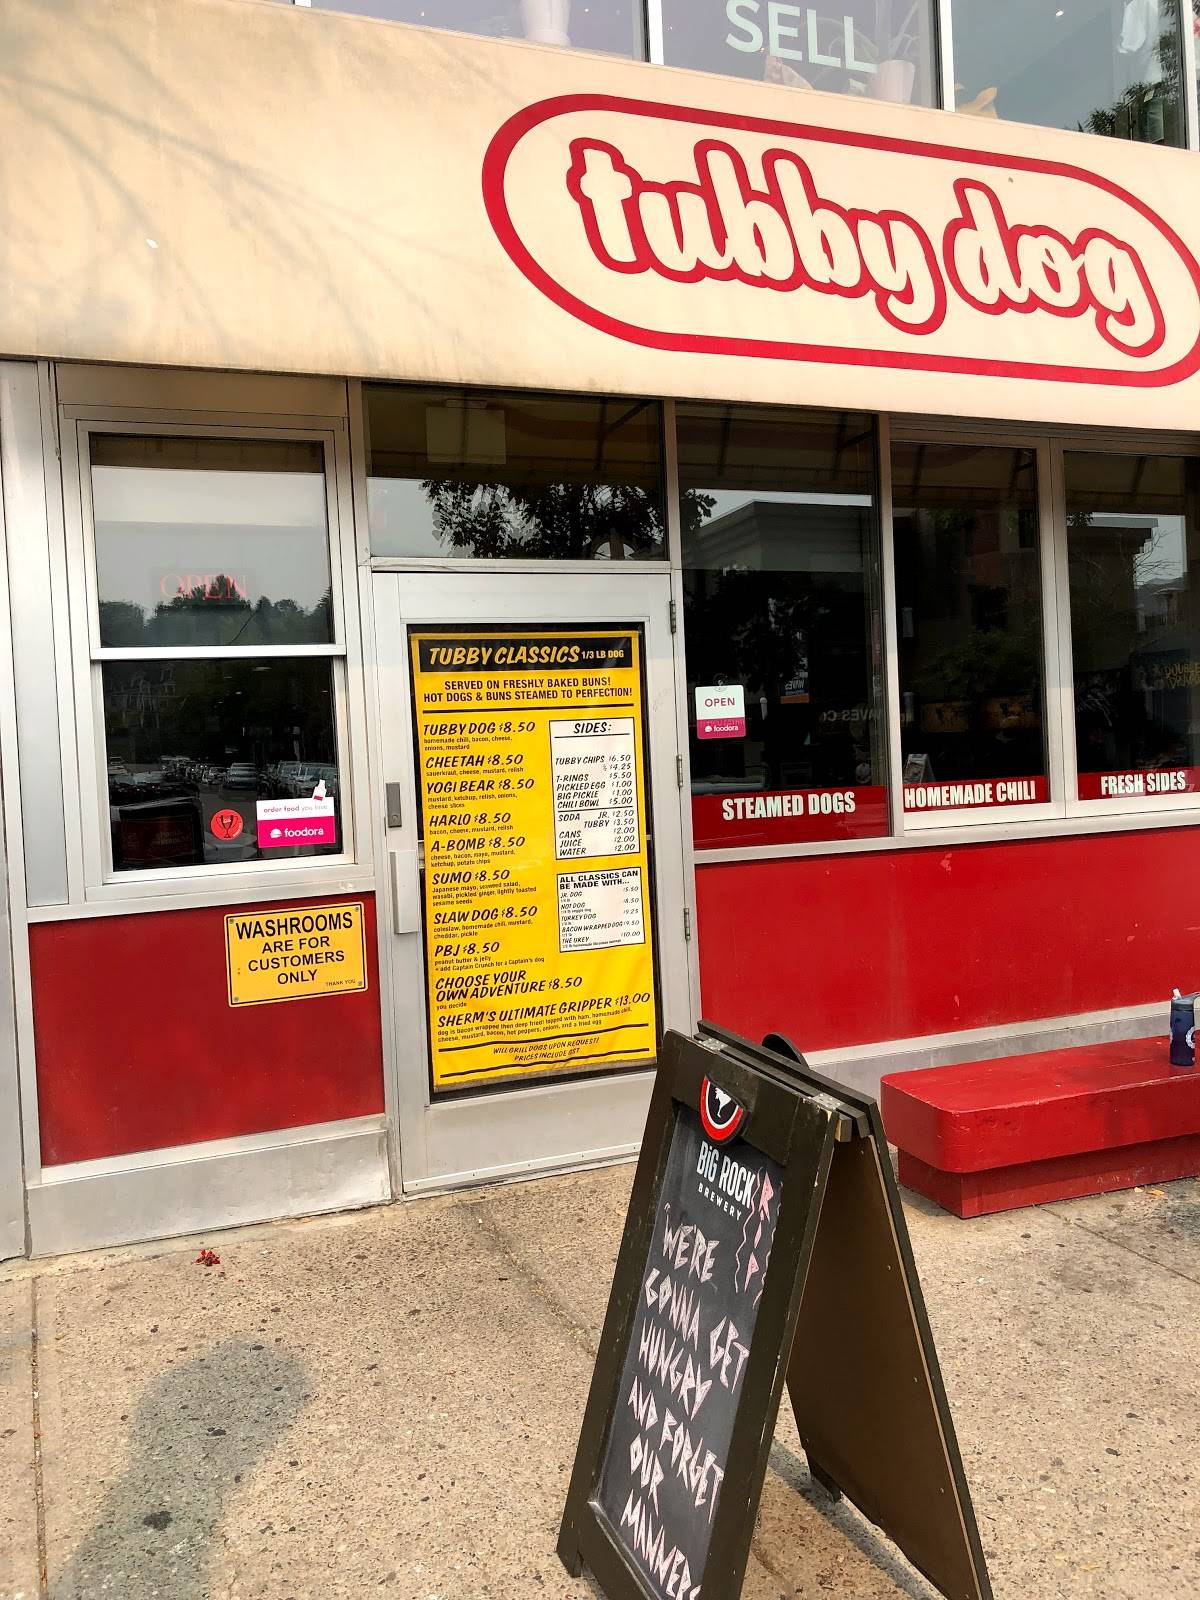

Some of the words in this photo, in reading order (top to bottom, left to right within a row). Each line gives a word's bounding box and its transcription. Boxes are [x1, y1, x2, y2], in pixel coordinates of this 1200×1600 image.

[724, 0, 877, 73] SELL
[566, 137, 947, 336] tubby
[943, 177, 1166, 358] dog
[160, 574, 247, 600] OPEN
[430, 647, 492, 665] TUBBY
[494, 645, 580, 664] CLASSICS
[581, 650, 594, 659] 1/3
[596, 650, 606, 658] LB
[608, 650, 624, 658] DOG
[445, 680, 483, 690] SERVED
[487, 680, 500, 689] ON
[504, 679, 545, 688] FRESHLY
[548, 678, 579, 687] BAKED
[582, 677, 611, 687] BUNS!
[424, 693, 442, 702] HOT
[446, 692, 473, 702] DOGS
[476, 693, 482, 701] &
[486, 692, 512, 701] BUNS
[515, 690, 558, 700] STEAMED
[562, 689, 573, 699] TO
[576, 687, 632, 698] PERFECTION!
[704, 697, 736, 707] OPEN
[424, 723, 467, 736] TUBBY
[469, 722, 496, 734] DOG
[499, 722, 536, 733] $8.50
[573, 722, 612, 734] SIDES:
[714, 724, 739, 732] foodora
[426, 755, 485, 769] CHEETAH
[487, 754, 524, 766] $8.50
[556, 756, 581, 766] TUBBY
[583, 755, 605, 764] CHIPS
[556, 774, 588, 782] T-RINGS
[1100, 773, 1145, 795] FRESH
[1147, 771, 1186, 792] SIDES
[427, 781, 456, 794] YOGI
[460, 780, 495, 792] BEAR
[498, 779, 535, 790] $8.50
[557, 783, 590, 792] PICKLED
[590, 781, 605, 790] EGG
[557, 793, 571, 801] BIG
[573, 790, 599, 799] PICKLE
[904, 783, 993, 809] HOMEMADE
[996, 780, 1036, 801] CHILI
[301, 804, 313, 812] you
[558, 800, 578, 809] CHILI
[579, 799, 600, 808] BOWL
[722, 794, 804, 820] STEAMED
[809, 792, 855, 815] DOGS
[474, 813, 511, 824] $8.50
[558, 813, 580, 822] SODA
[584, 820, 610, 828] TUBBY
[284, 827, 324, 837] foodora
[559, 830, 581, 839] CANS
[430, 837, 485, 852] A-BOMB
[489, 837, 525, 848] $8.50
[560, 839, 582, 848] JUICE
[560, 848, 587, 856] WATER
[432, 871, 472, 885] SUMO
[475, 869, 510, 881] $8.50
[573, 880, 599, 889] MADE
[602, 879, 629, 887] WITH...
[578, 872, 620, 882] CLASSICS
[432, 886, 460, 894] Japanese
[434, 911, 470, 925] SLAW
[471, 908, 499, 922] DOG
[502, 906, 538, 918] $8.50
[236, 912, 353, 940] WASHROOMS
[561, 925, 582, 933] BACON
[583, 923, 611, 931] WRAPPED
[262, 939, 294, 954] ARE
[299, 936, 330, 950] FOR
[435, 944, 460, 957] PBJ
[463, 942, 500, 955] $8.50
[248, 950, 345, 972] CUSTOMERS
[475, 962, 495, 970] Crunch
[278, 969, 317, 984] ONLY
[435, 974, 490, 990] CHOOSE
[493, 970, 526, 985] YOUR
[436, 989, 469, 1002] OWN
[470, 980, 546, 999] ADVENTURE
[549, 976, 583, 990] $8.50
[438, 1011, 497, 1028] SHERM'S
[499, 1004, 557, 1021] ULTIMATE
[560, 997, 612, 1014] GRIPPER
[615, 992, 650, 1006] $13.00
[548, 1041, 566, 1050] UPON
[567, 1037, 600, 1048] REQUEST!
[514, 1053, 538, 1061] PRICES
[539, 1051, 567, 1059] INCLUDE
[718, 1155, 756, 1209] ROCK
[698, 1182, 742, 1221] BREWERY
[645, 1268, 701, 1352] GONNA
[709, 1316, 750, 1395] GET
[639, 1317, 713, 1421] HUNGRY
[628, 1376, 659, 1431] AND
[659, 1407, 725, 1524] FORGET
[630, 1432, 665, 1517] OUR
